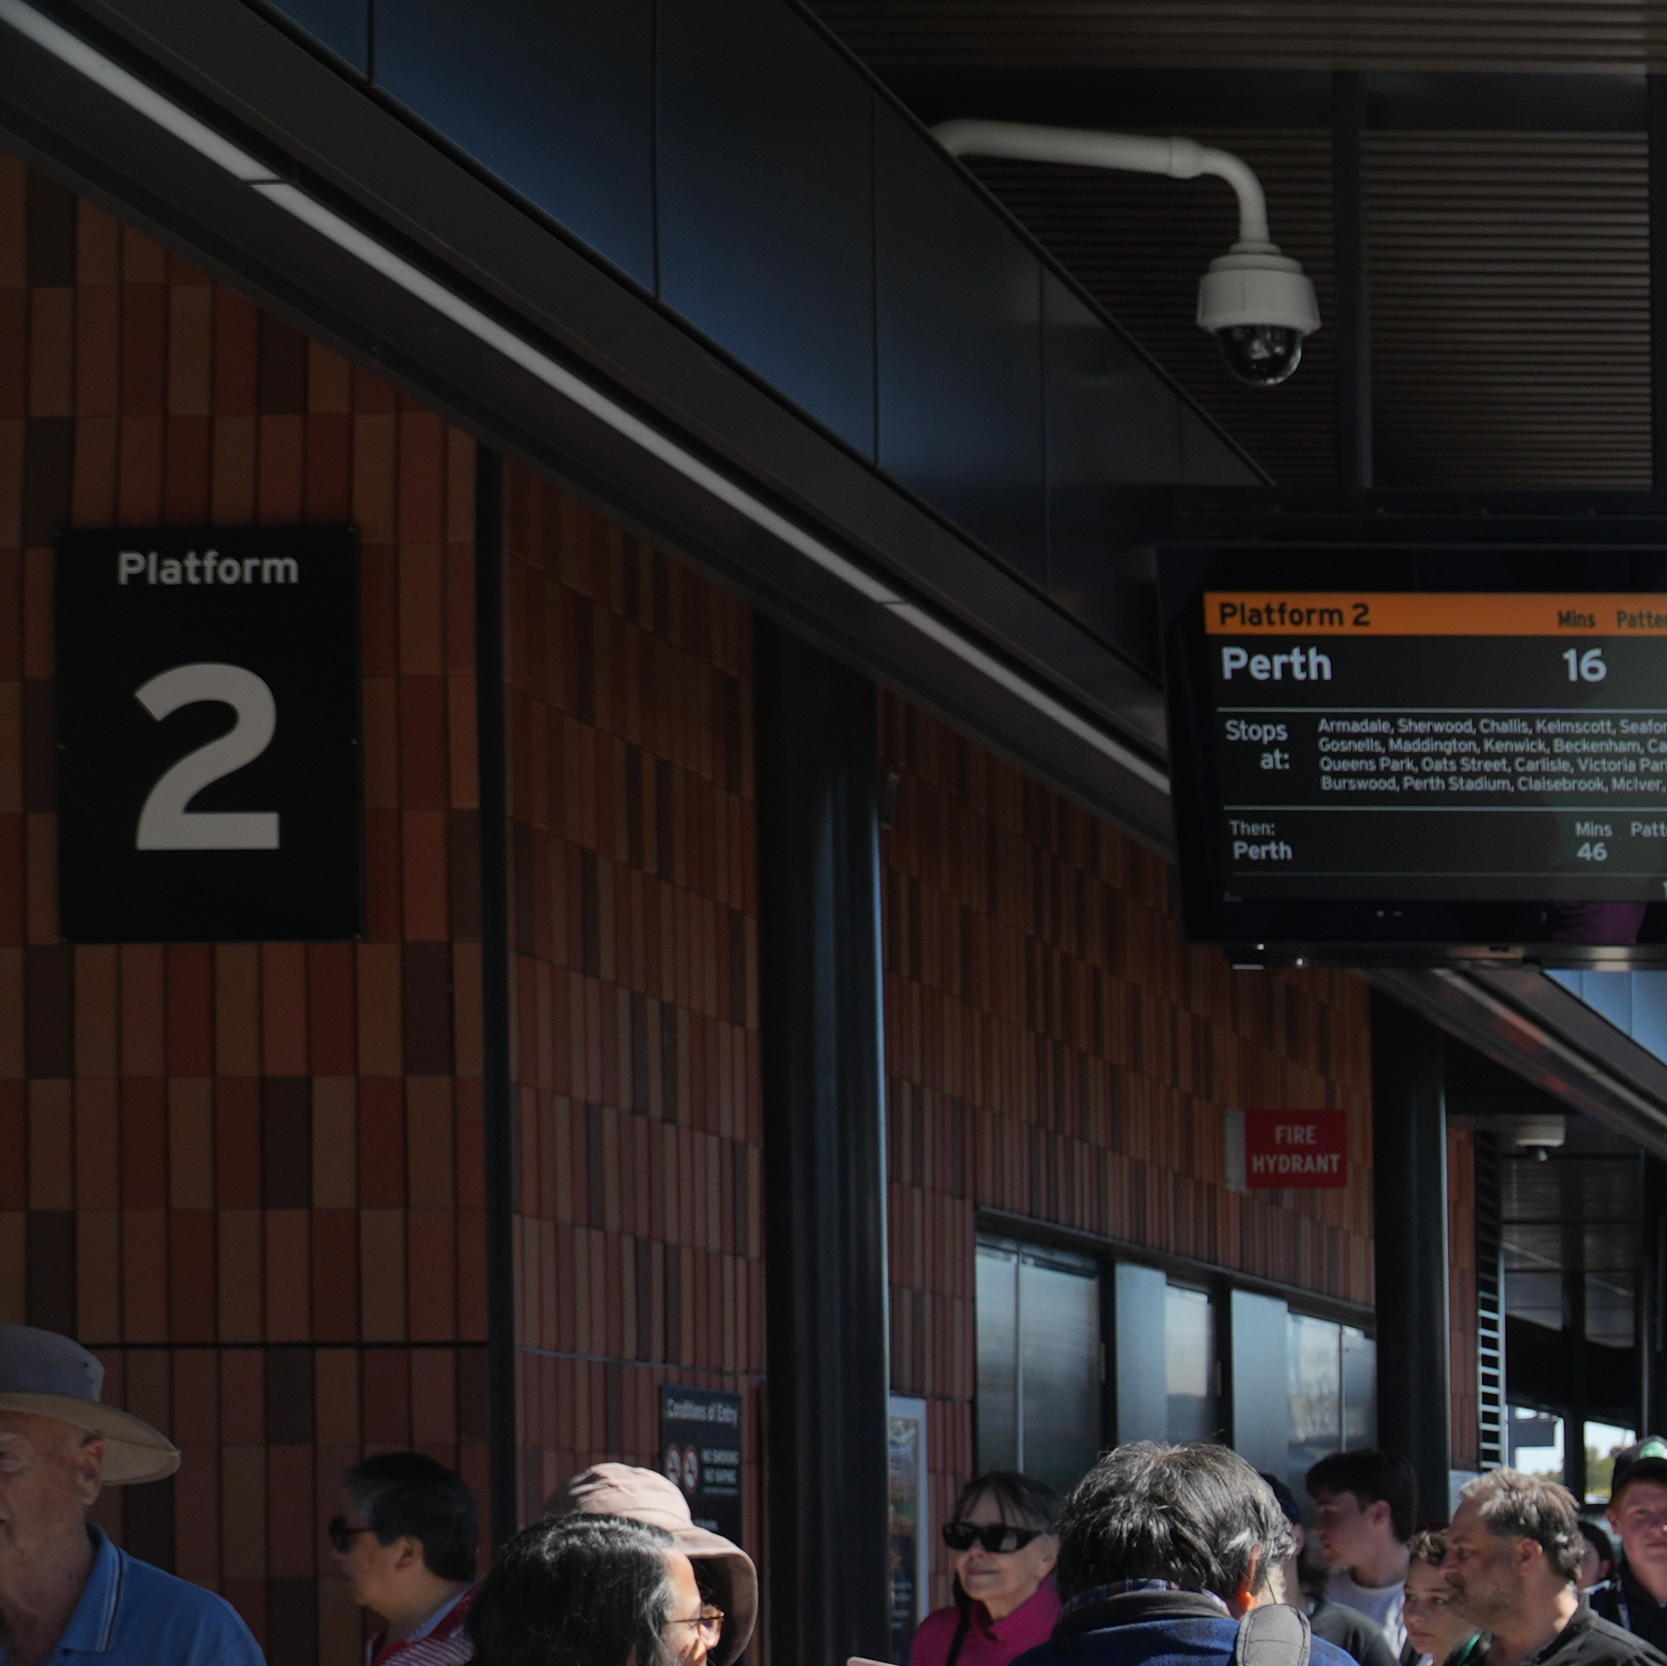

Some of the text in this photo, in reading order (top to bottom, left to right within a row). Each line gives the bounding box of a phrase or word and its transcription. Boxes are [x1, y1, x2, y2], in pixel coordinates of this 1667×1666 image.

[118, 550, 299, 585] Platform
[1219, 602, 1371, 627] Platform 2
[1557, 609, 1597, 629] Mins
[1221, 646, 1332, 681] Perth
[1562, 648, 1608, 682] 16
[1225, 719, 1289, 745] Stops
[1318, 718, 1394, 734] Armadale,
[1397, 718, 1477, 735] Sherwood,
[1479, 718, 1533, 735] Challis,
[1535, 719, 1617, 736] Kelmscott,
[135, 662, 281, 851] 2
[1318, 737, 1386, 754] Gosnells,
[1388, 737, 1481, 755] Maddington,
[1483, 738, 1551, 755] Kenwick,
[1553, 738, 1645, 755] Beckenham,
[1260, 748, 1291, 770] at:
[1319, 756, 1377, 772] Queens
[1380, 756, 1418, 772] Park,
[1421, 757, 1457, 772] Oats
[1460, 757, 1512, 773] Street,
[1514, 757, 1575, 774] Carlisle,
[1577, 757, 1637, 773] Victoria
[1321, 776, 1400, 792] Burswood,
[1402, 776, 1446, 791] Perth
[1448, 776, 1515, 793] Stadium,
[1517, 776, 1609, 793] Claisebrook,
[1611, 776, 1666, 793] McIver,
[1230, 820, 1276, 836] Then:
[1576, 821, 1613, 837] Mins
[1232, 840, 1293, 861] Perth
[1577, 842, 1608, 861] 46
[1275, 1124, 1318, 1145] FIRE
[1251, 1153, 1341, 1174] HYDRANT
